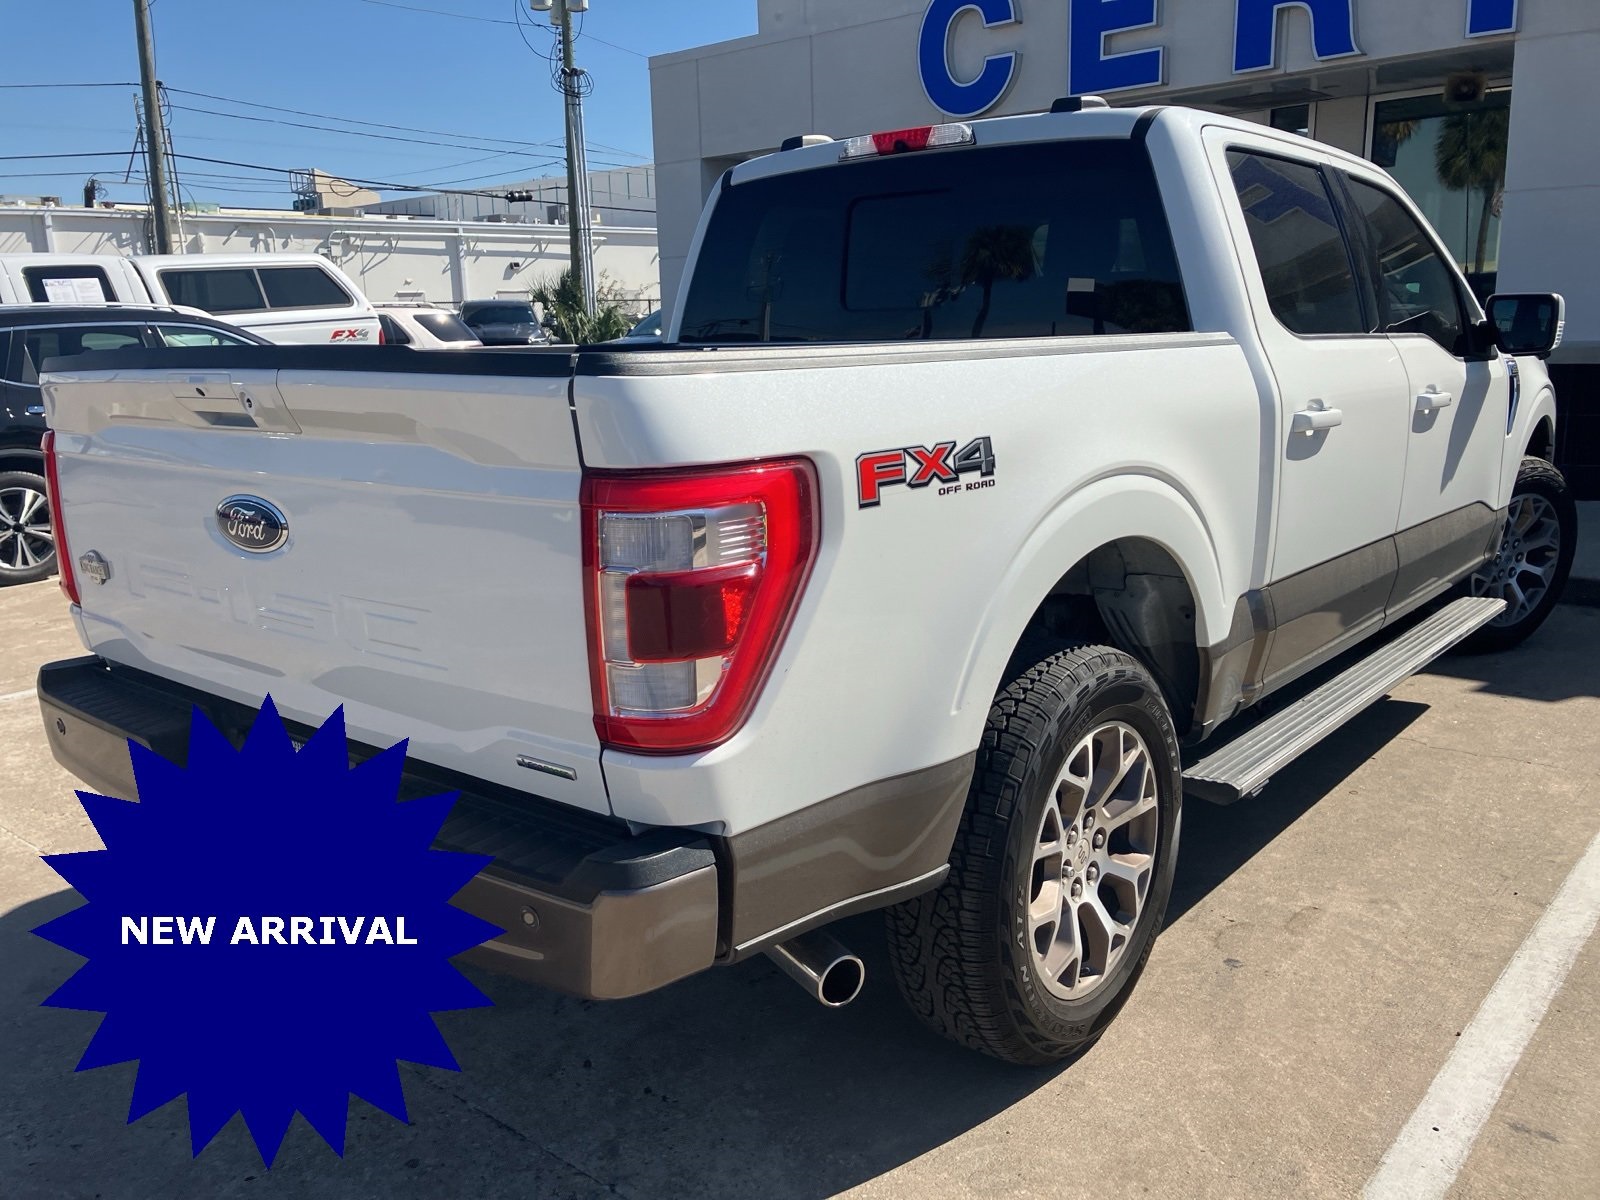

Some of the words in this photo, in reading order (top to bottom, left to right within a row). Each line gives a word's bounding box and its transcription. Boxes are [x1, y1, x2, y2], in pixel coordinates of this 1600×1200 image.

[918, 0, 1519, 117] CE
[330, 328, 369, 340] FX4
[855, 435, 996, 510] FX4
[938, 484, 962, 496] OFF
[965, 479, 996, 491] ROAD
[228, 506, 265, 540] Ford
